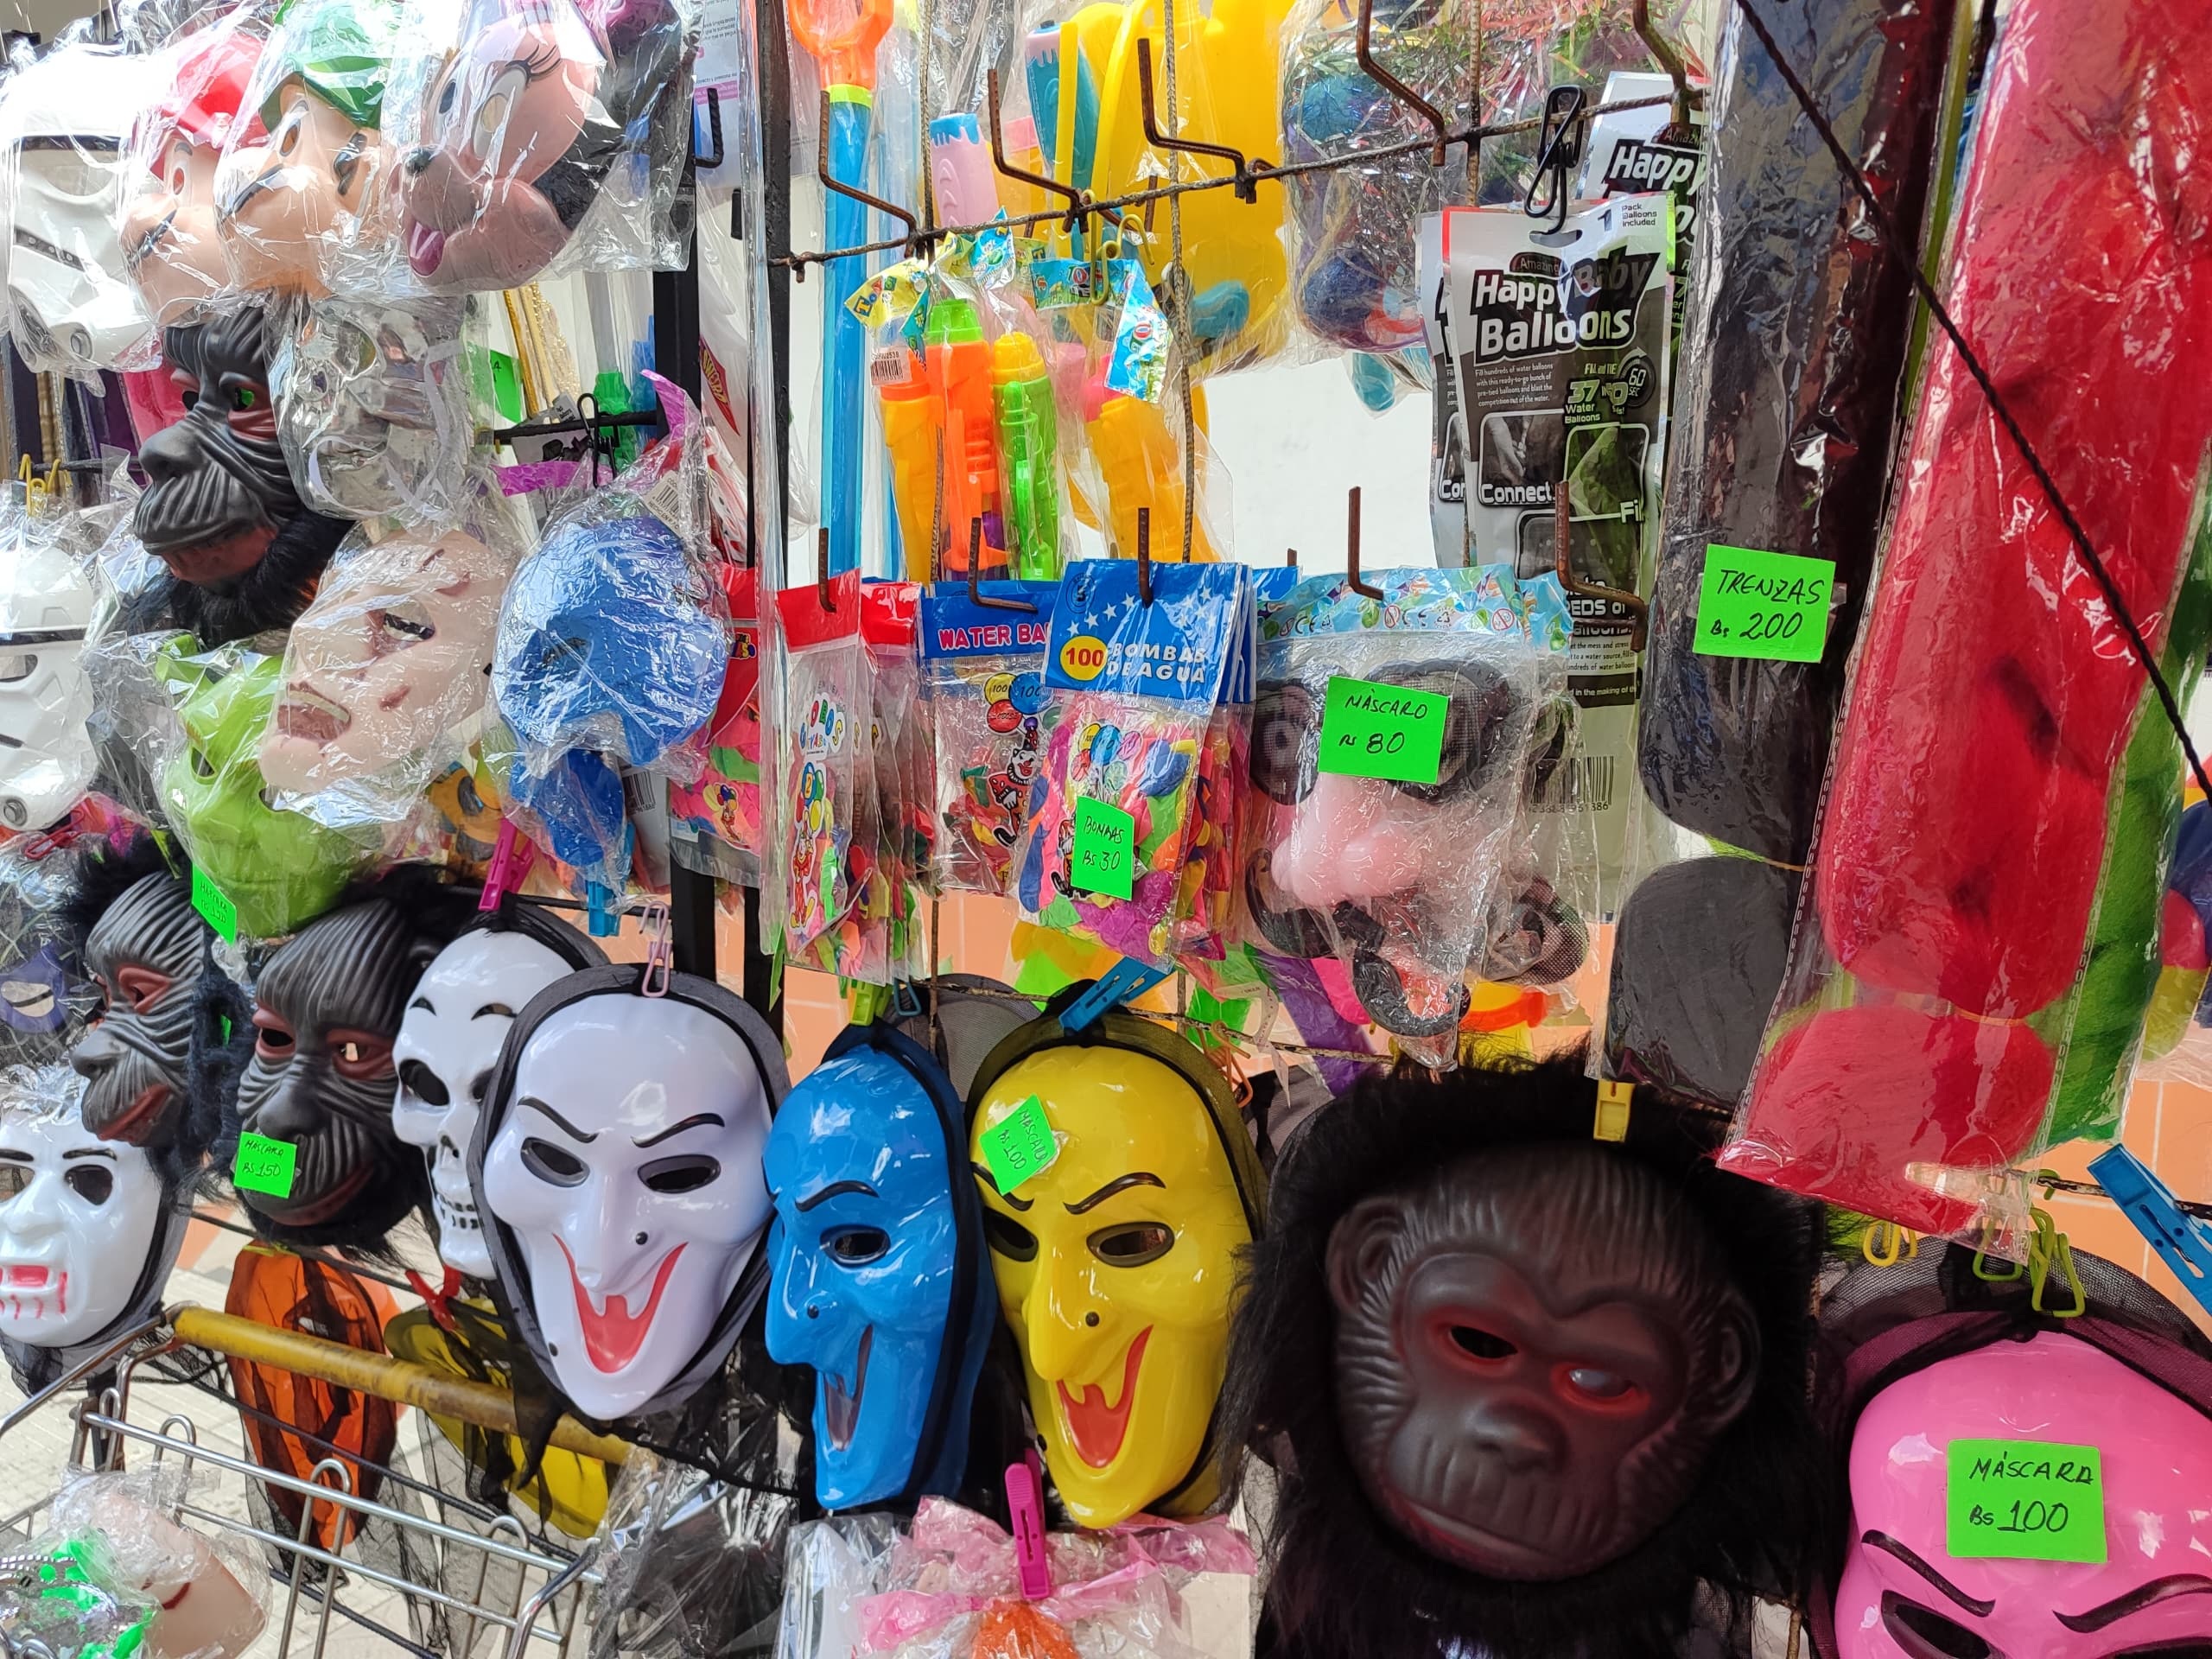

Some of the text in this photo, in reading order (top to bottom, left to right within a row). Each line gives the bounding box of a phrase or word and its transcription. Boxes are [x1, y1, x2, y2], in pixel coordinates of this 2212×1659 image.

[1597, 209, 1612, 232] 1
[1622, 211, 1657, 219] Balloons
[1519, 257, 1560, 275] Amazing
[1474, 275, 1575, 316] Happy
[1480, 308, 1633, 357] Balloons
[1499, 376, 1529, 385] ready-to-go
[1628, 368, 1646, 386] 60
[1567, 379, 1600, 404] 37
[1565, 403, 1595, 414] Water
[1565, 413, 1600, 424] Balloons
[1480, 480, 1552, 504] Connect
[1716, 569, 1825, 605] TRENZAS
[1739, 612, 1803, 640] 200
[938, 625, 1011, 651] WATER
[1602, 640, 1613, 649] and
[1065, 642, 1206, 667] 100 BOMBAS
[1591, 662, 1597, 671] of
[993, 683, 1007, 694] 100
[1366, 731, 1405, 754] 80
[1098, 850, 1122, 872] 30
[1003, 1143, 1027, 1170] 100
[255, 1161, 282, 1177] 150
[1969, 1499, 2069, 1533] Bs 100
